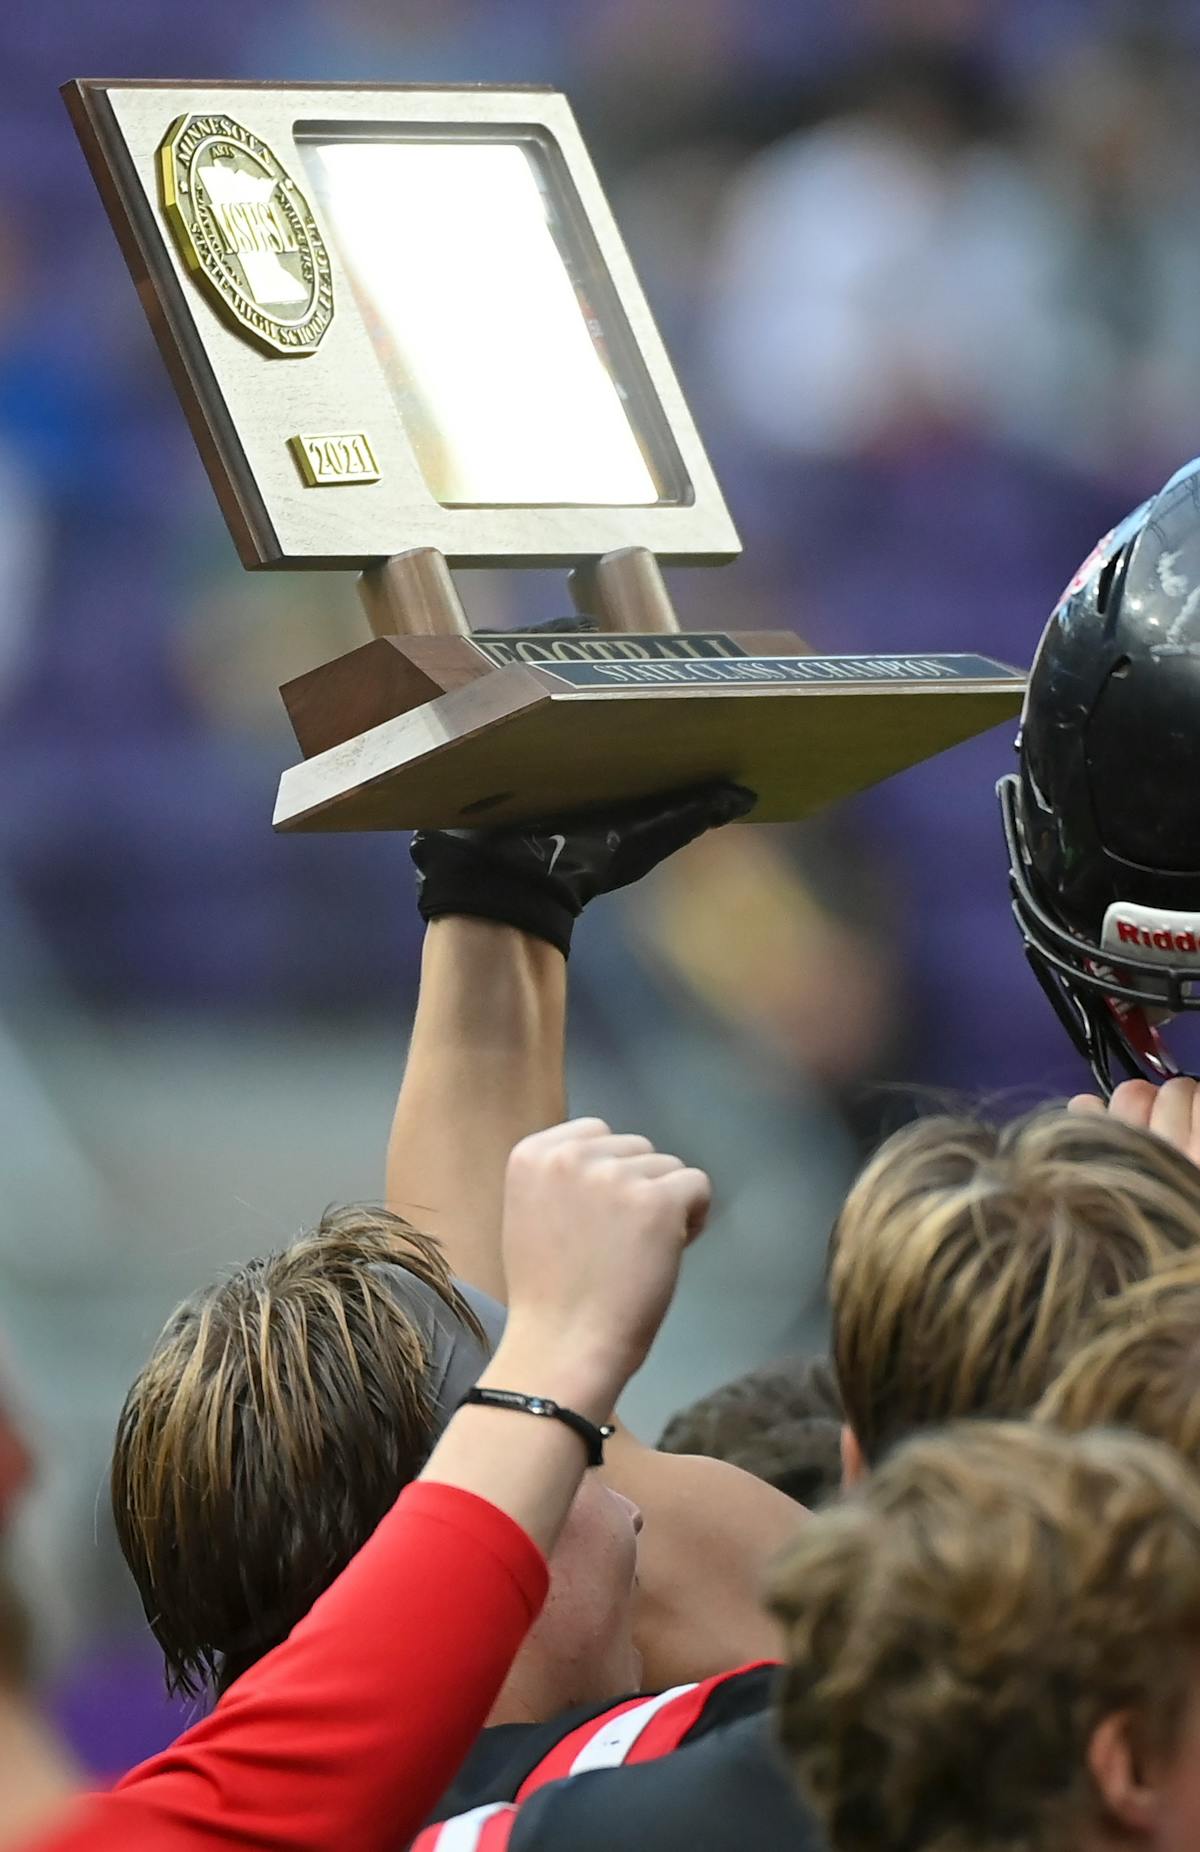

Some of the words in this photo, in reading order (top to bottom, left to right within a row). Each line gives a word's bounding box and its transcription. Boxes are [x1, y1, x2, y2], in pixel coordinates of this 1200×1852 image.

[177, 117, 271, 169] MINNESOTA
[189, 222, 230, 289] STATE
[231, 291, 277, 341] HIGH
[277, 309, 329, 346] SCHOOL
[309, 438, 373, 475] 2021
[592, 663, 686, 682] STATE
[684, 661, 787, 681] CLASS
[797, 659, 961, 679] CHAMPION
